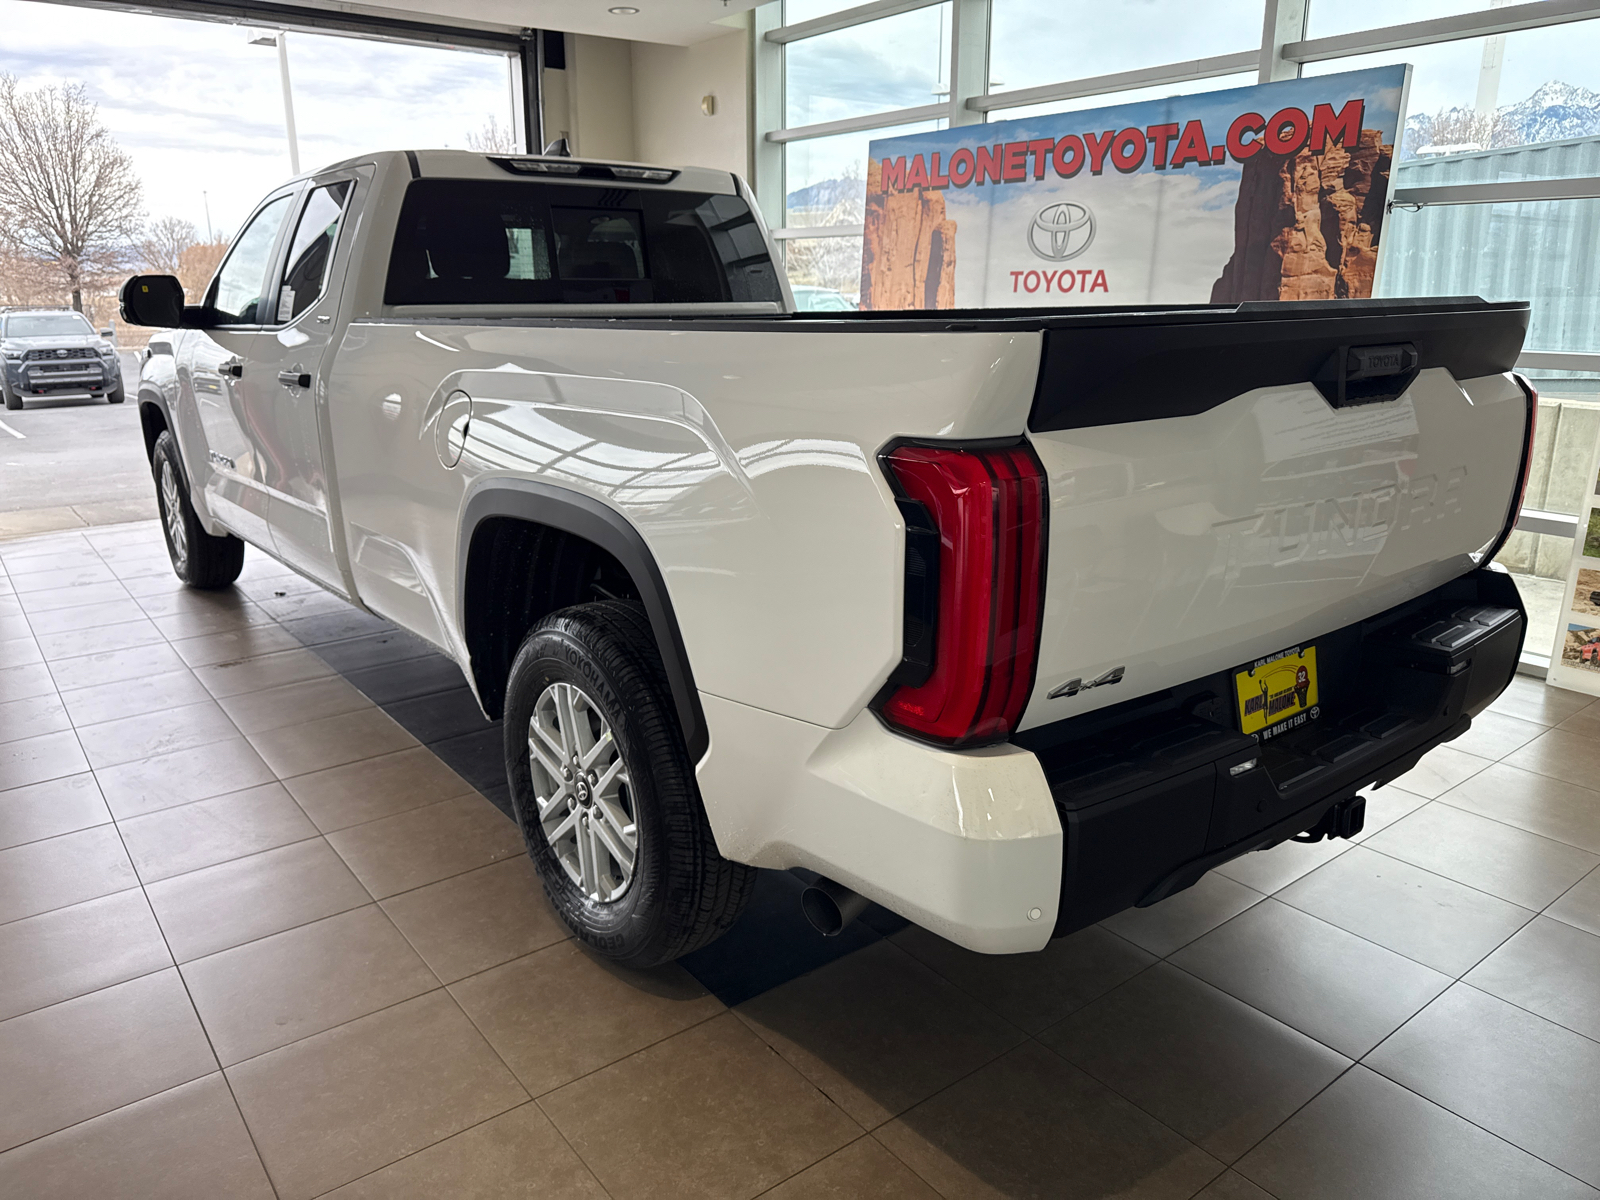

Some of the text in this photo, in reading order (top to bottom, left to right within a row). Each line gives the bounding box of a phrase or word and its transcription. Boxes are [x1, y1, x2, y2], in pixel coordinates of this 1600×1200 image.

[881, 98, 1365, 195] MALONETOYOTA.COM
[1009, 268, 1109, 294] TOYOTA
[1368, 353, 1399, 368] TOYOTA
[1211, 465, 1468, 579] TUNDRA
[1254, 658, 1266, 668] KARL
[1266, 652, 1284, 663] MALONE
[564, 645, 622, 722] YOKOHAMA
[1297, 671, 1306, 682] 32
[1244, 694, 1264, 717] KARL
[1268, 690, 1296, 716] MALONE
[1263, 728, 1272, 739] WE
[1272, 722, 1287, 736] MAKE
[1288, 718, 1294, 729] IT
[1294, 713, 1306, 726] EASY
